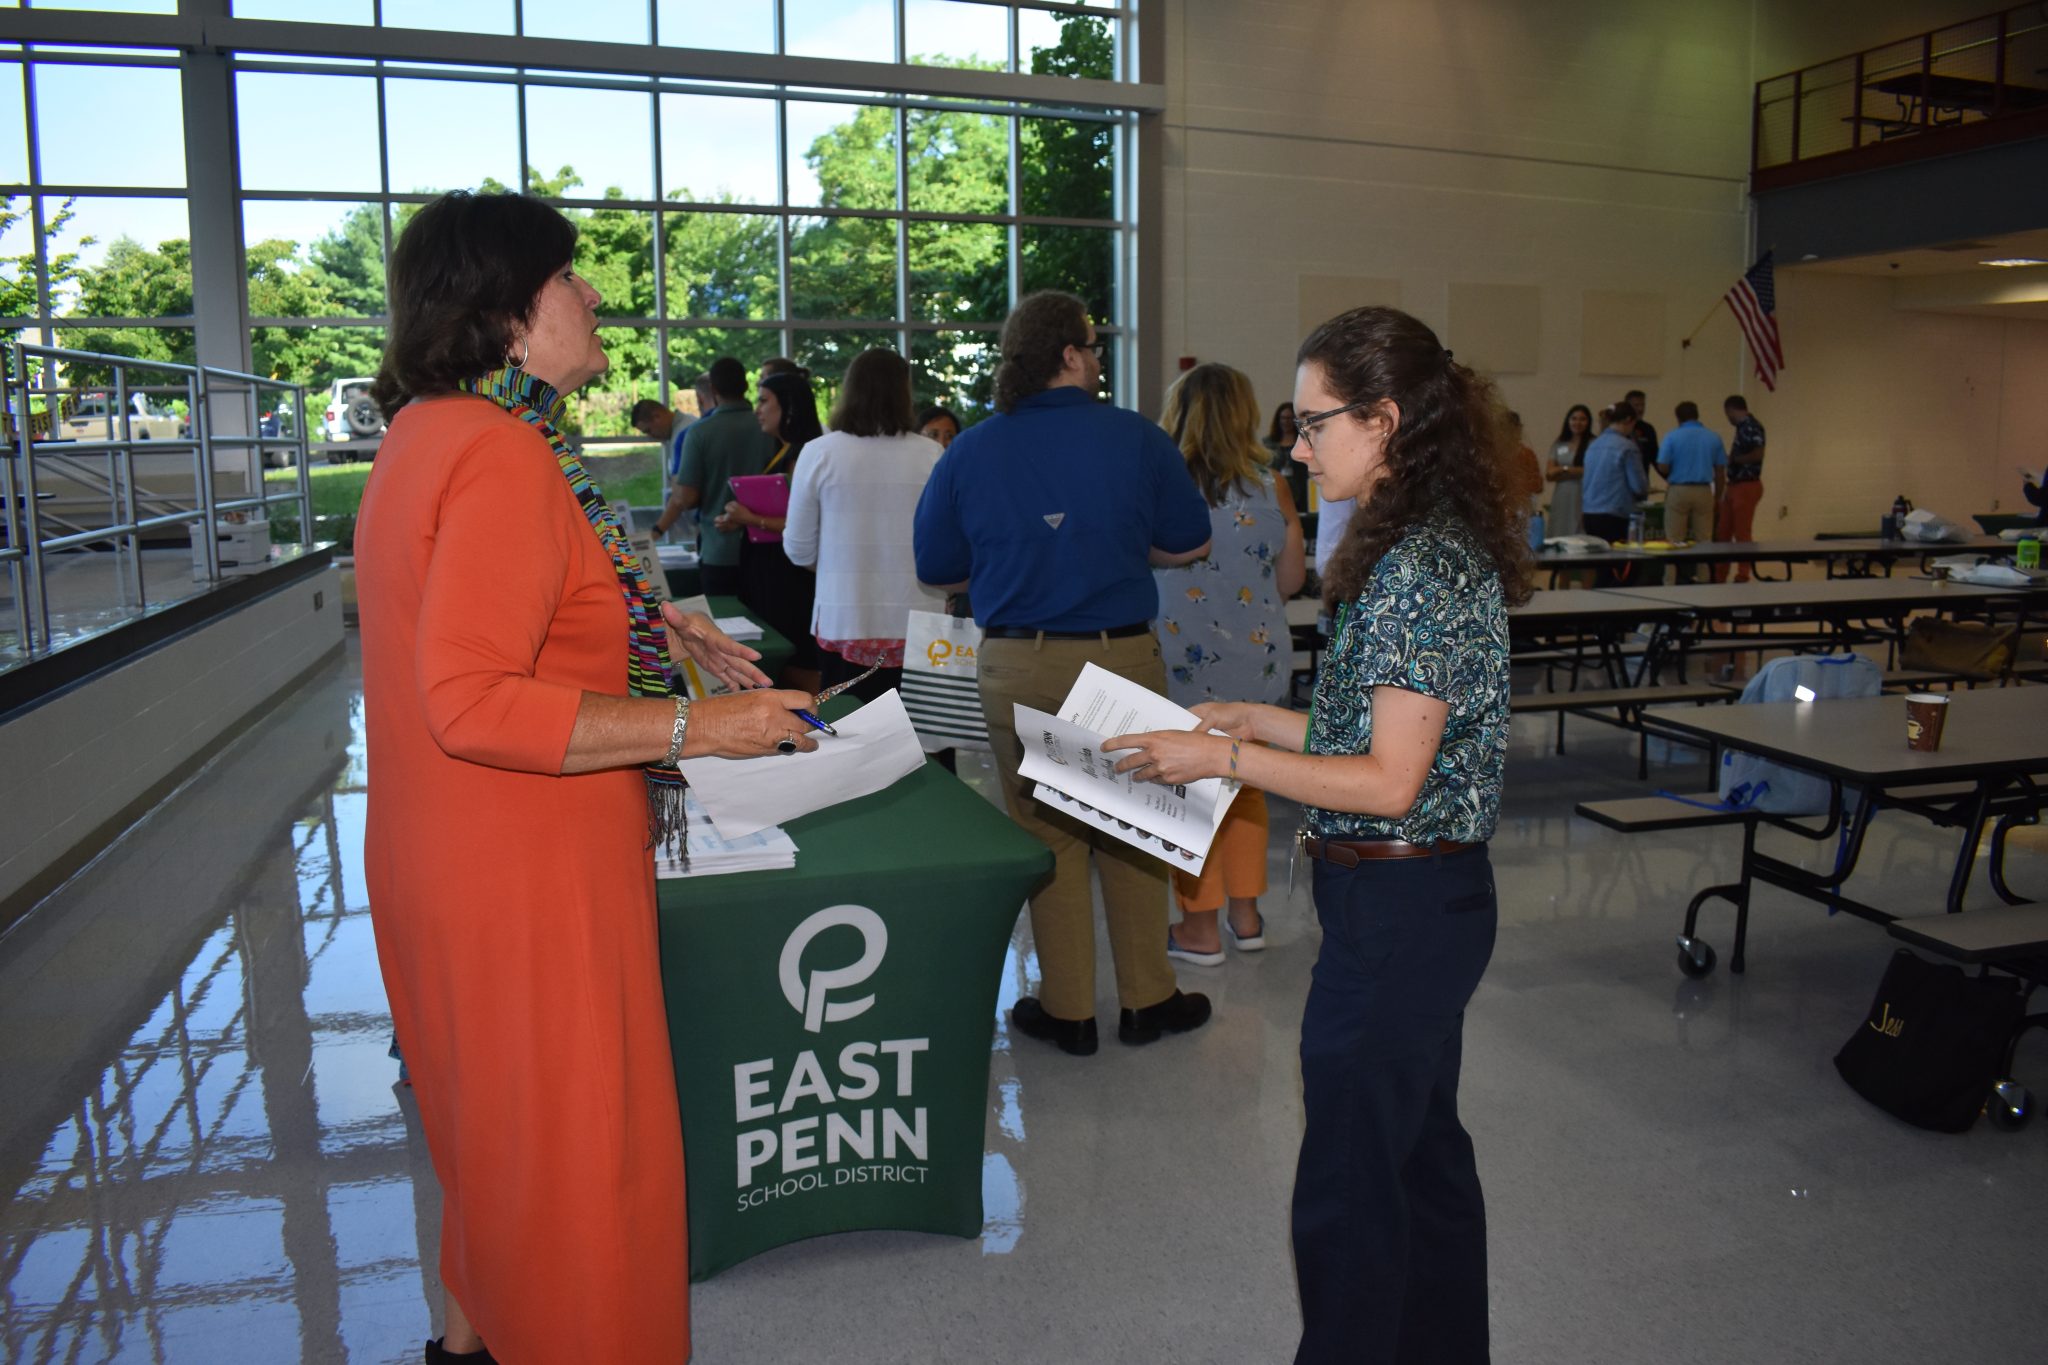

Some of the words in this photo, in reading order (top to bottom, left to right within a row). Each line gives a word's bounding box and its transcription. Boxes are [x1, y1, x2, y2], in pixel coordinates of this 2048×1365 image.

[734, 1037, 930, 1123] EAST
[736, 1107, 929, 1189] PENN
[737, 1172, 829, 1212] SCHOOL
[835, 1165, 929, 1184] DISTRICT
